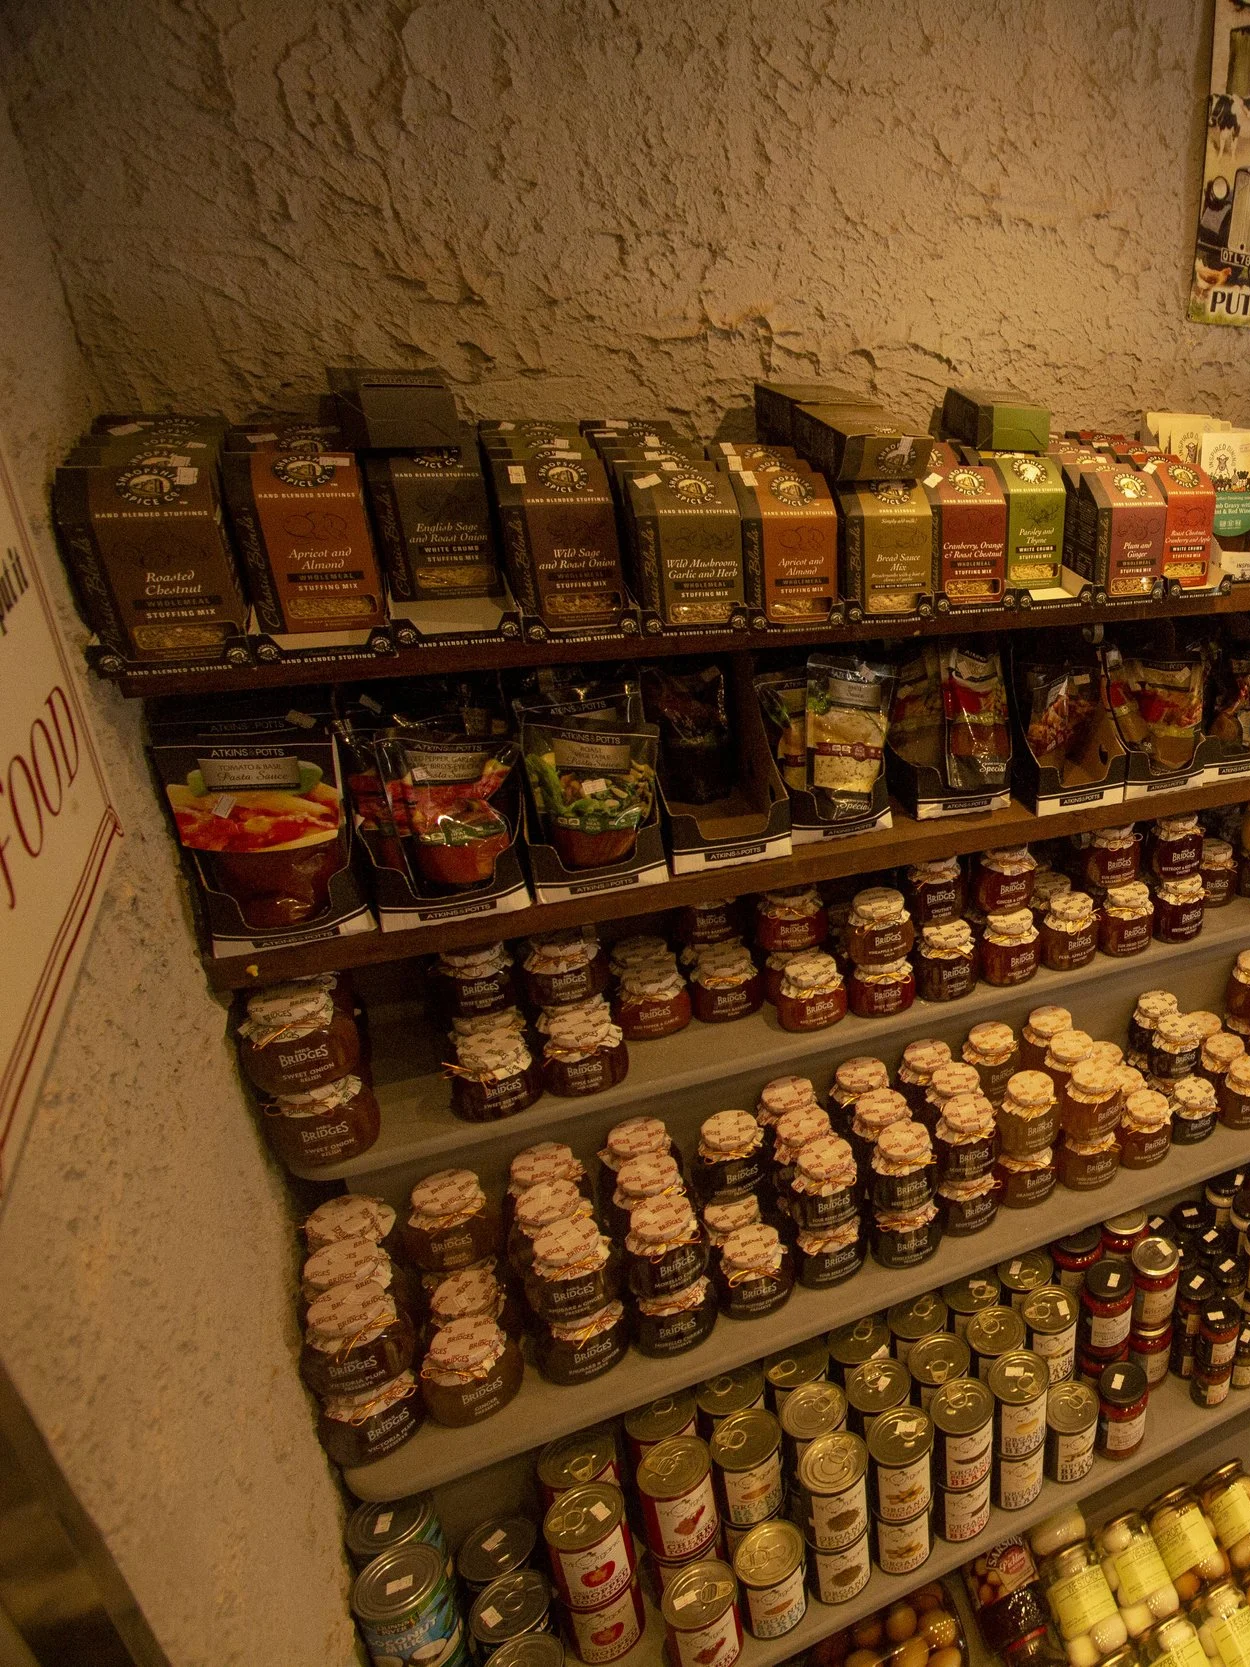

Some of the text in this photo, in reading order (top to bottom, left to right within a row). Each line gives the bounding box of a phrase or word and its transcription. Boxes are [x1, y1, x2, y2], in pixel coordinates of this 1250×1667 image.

[537, 460, 588, 479] SHROPSHIRE
[280, 473, 313, 488] SPICE
[544, 480, 574, 494] SPICE
[669, 478, 715, 492] SHROPSHIRE
[121, 491, 161, 506] SPICE
[416, 522, 478, 534] English Sage
[409, 533, 489, 544] and Roast Onion
[980, 541, 1004, 550] Orange
[288, 547, 353, 560] Apricot and
[426, 555, 463, 563] STUFFING
[553, 548, 601, 560] Wild Sage
[876, 553, 921, 563] Bread Sauce
[953, 550, 972, 558] Roast
[973, 550, 1002, 558] Chestnut
[301, 559, 346, 570] Almond
[539, 558, 616, 570] and Roast Onion
[666, 559, 739, 569] Wild Mushroom,
[778, 556, 824, 567] Apricot and
[890, 563, 907, 572] Mix
[145, 570, 195, 584] Roasted
[668, 568, 738, 579] Garlic and Herb
[786, 566, 818, 576] Almond
[145, 584, 202, 596] Chestnut
[298, 582, 359, 592] STUFFING MIX
[556, 581, 592, 589] STUFFING
[146, 608, 216, 619] STUFFING MIX
[304, 655, 336, 663] BLENDED
[338, 653, 376, 661] STUFFINGS
[152, 667, 188, 675] BLENDED
[190, 664, 233, 672] STUFFINGS
[262, 763, 283, 771] BASIL
[216, 770, 288, 783] Pasta Sauce
[780, 923, 809, 935] BRIDGES
[942, 964, 970, 980] BRIDGES
[551, 972, 586, 989] BRIDGES
[461, 979, 500, 996] BRIDGES
[638, 1006, 672, 1021] BRIDGES
[806, 999, 834, 1016] BRIDGES
[278, 1044, 329, 1069] BRIDGES
[282, 1061, 335, 1082] SWEET ONION
[566, 1061, 603, 1078] BRIDGES
[300, 1121, 349, 1143] BRIDGES
[304, 1137, 356, 1156] SWEET ONION
[959, 1148, 988, 1164] BRIDGES
[817, 1196, 851, 1213] BRIDGES
[659, 1254, 696, 1275] BRIDGES
[552, 1283, 595, 1303] BRIDGES
[573, 1340, 612, 1364] BRIDGES
[461, 1377, 503, 1405] BRIDGES
[367, 1408, 409, 1441] BRIDGES
